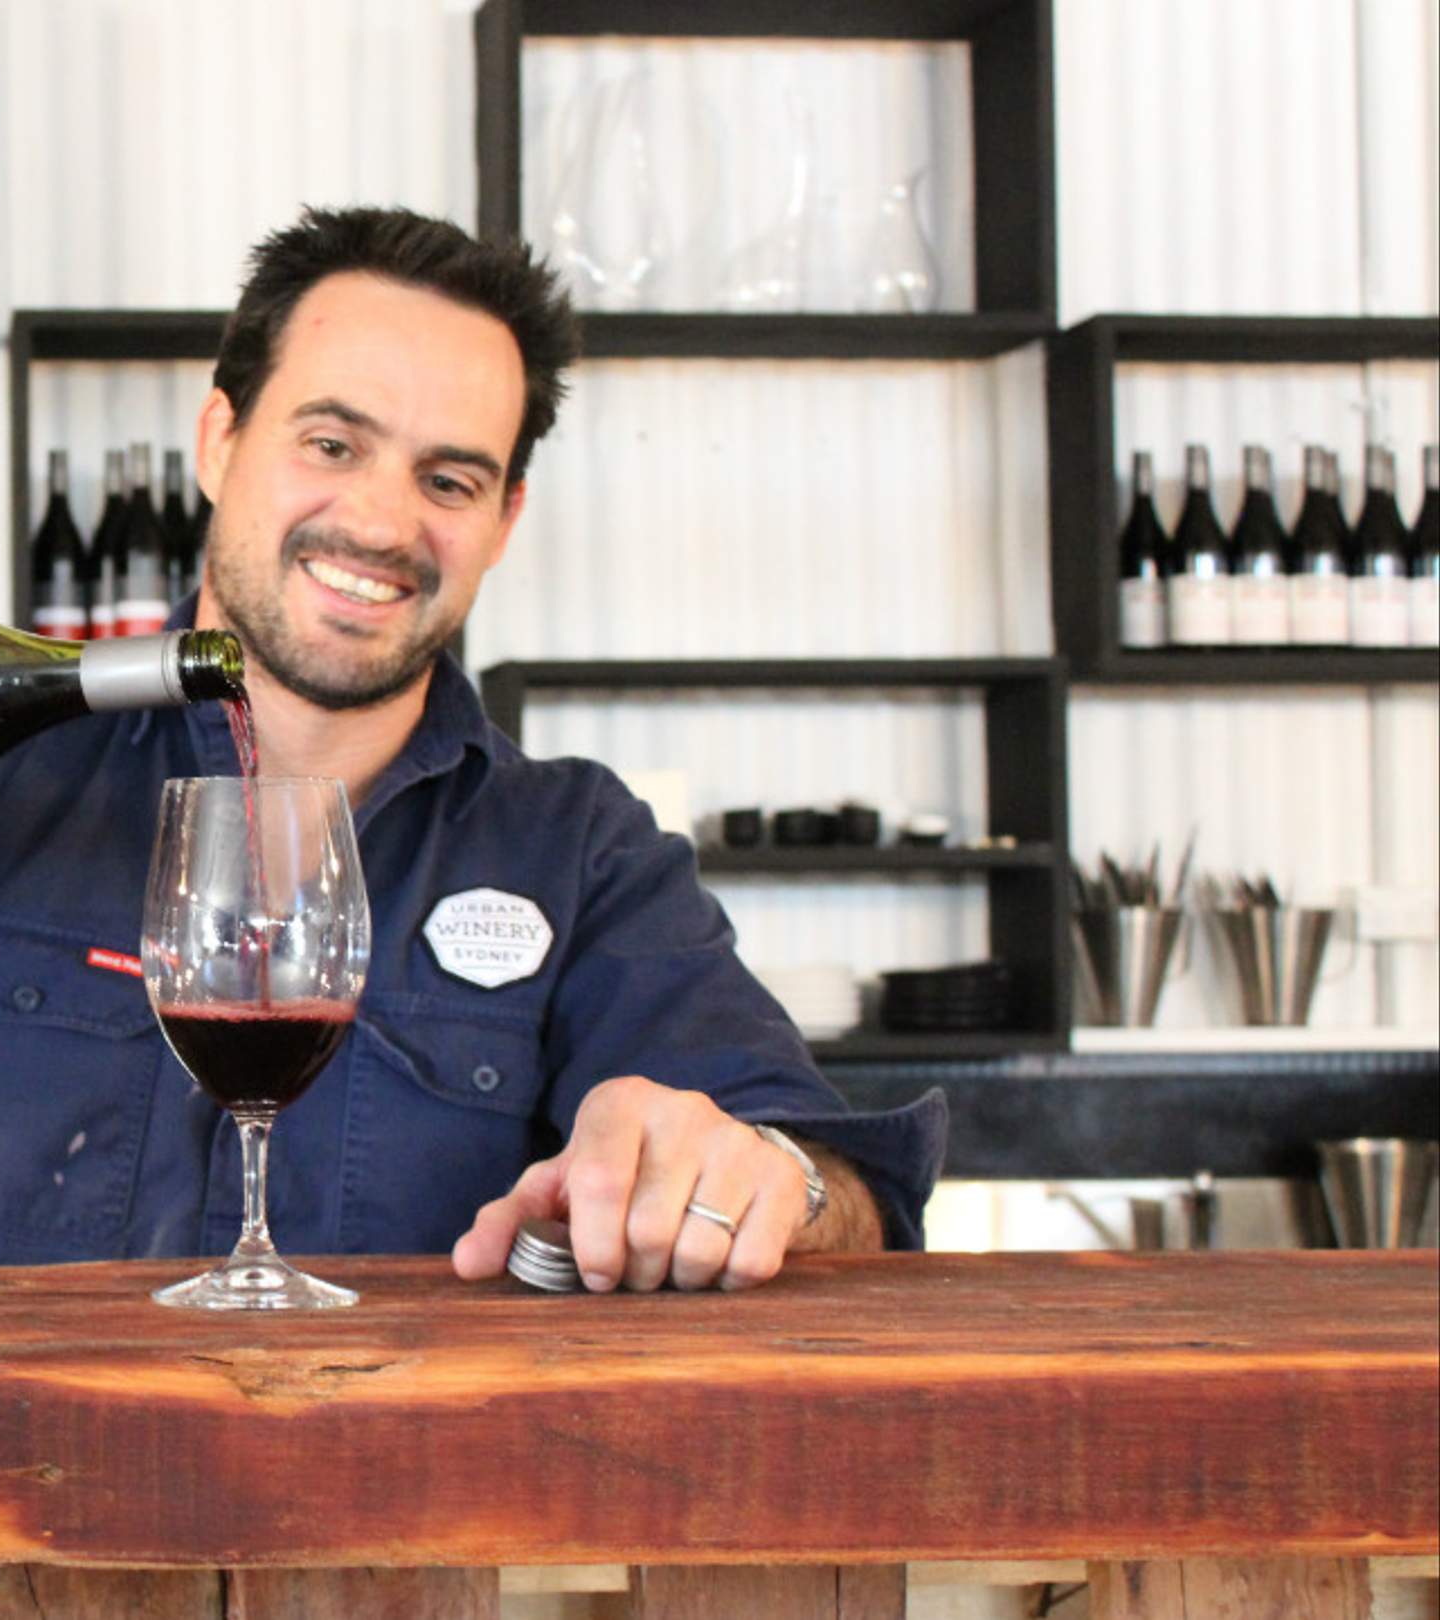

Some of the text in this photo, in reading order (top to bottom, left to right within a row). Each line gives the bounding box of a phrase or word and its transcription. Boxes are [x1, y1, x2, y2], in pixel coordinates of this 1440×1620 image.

[450, 903, 525, 914] URBAN
[435, 919, 541, 941] WINERY
[454, 947, 524, 963] SYDNEY
